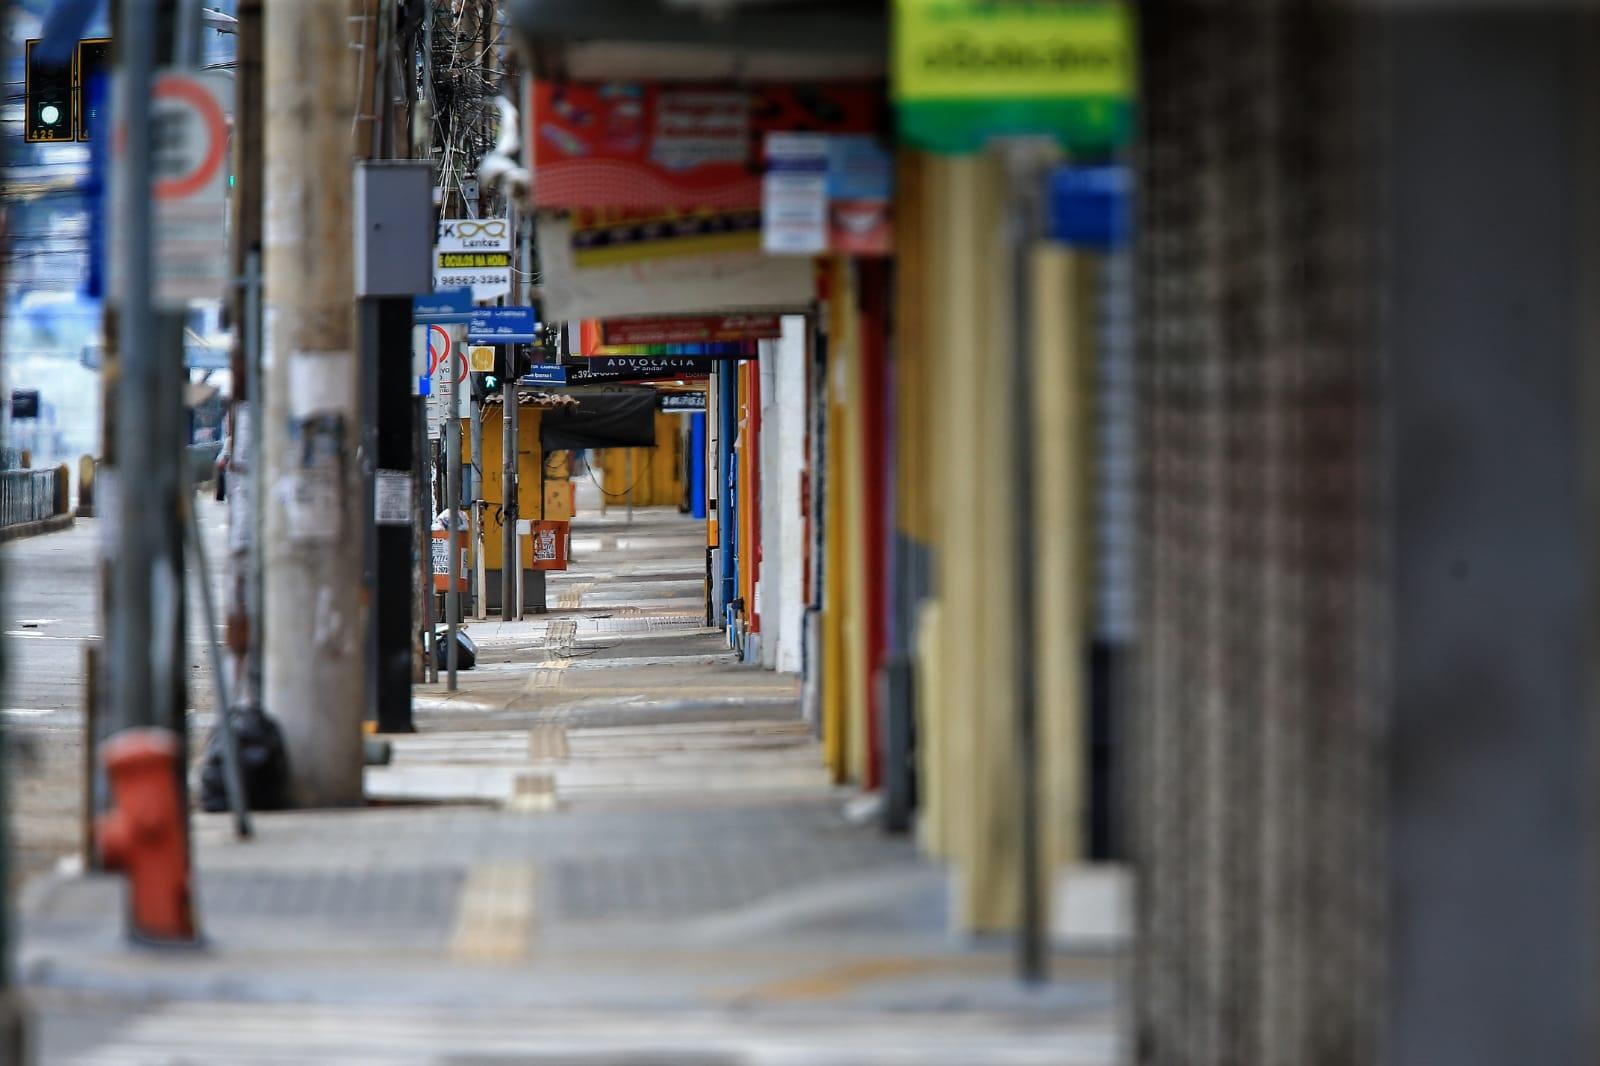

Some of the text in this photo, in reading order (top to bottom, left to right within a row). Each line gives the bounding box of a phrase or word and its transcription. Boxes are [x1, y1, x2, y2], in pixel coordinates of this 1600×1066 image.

[32, 130, 54, 140] 425
[462, 238, 501, 248] Lentes
[607, 358, 695, 367] ADVOCACIA
